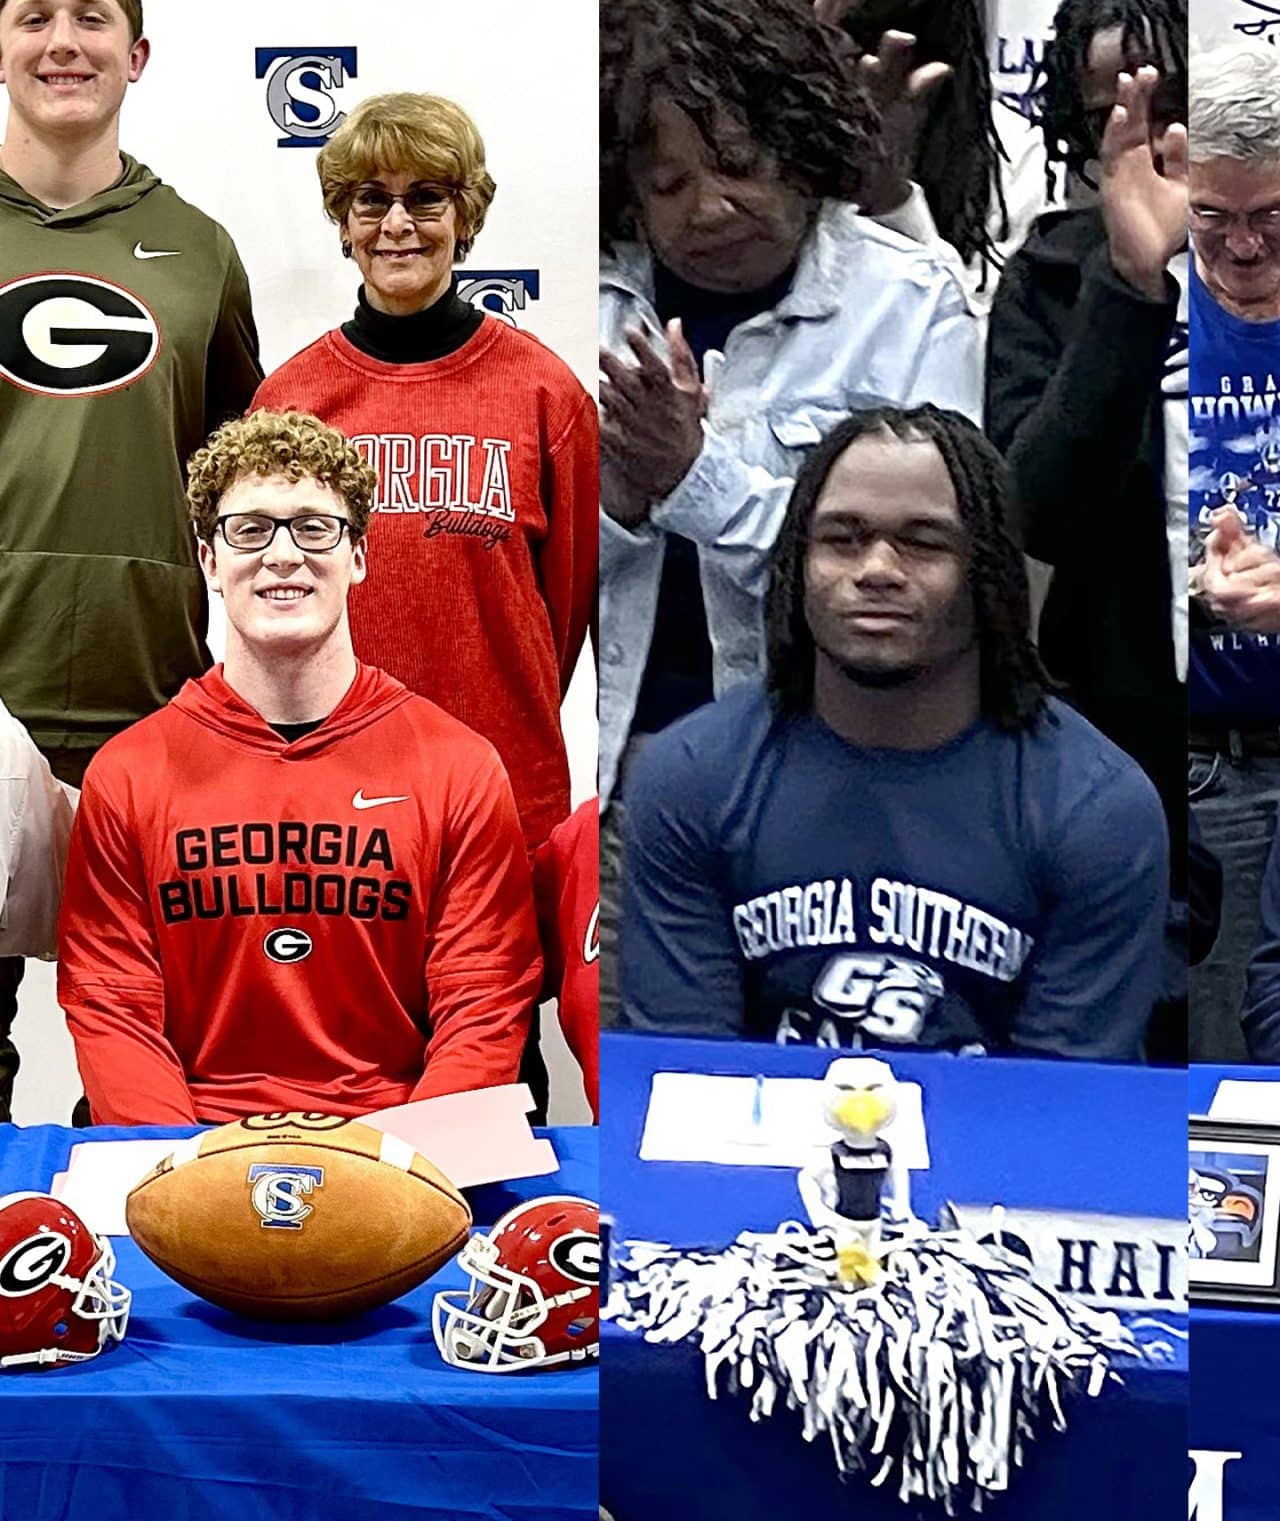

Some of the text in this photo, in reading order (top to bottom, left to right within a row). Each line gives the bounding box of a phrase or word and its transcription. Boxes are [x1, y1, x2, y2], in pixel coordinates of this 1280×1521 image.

[350, 433, 516, 523] ORGIA
[423, 508, 513, 549] Bulldogs
[174, 821, 395, 872] GEORGIA
[157, 872, 413, 924] BULLDOGS
[264, 928, 312, 963] G
[733, 877, 1035, 983] GEORGIA SOUTHERN
[1054, 1237, 1188, 1301] HAI
